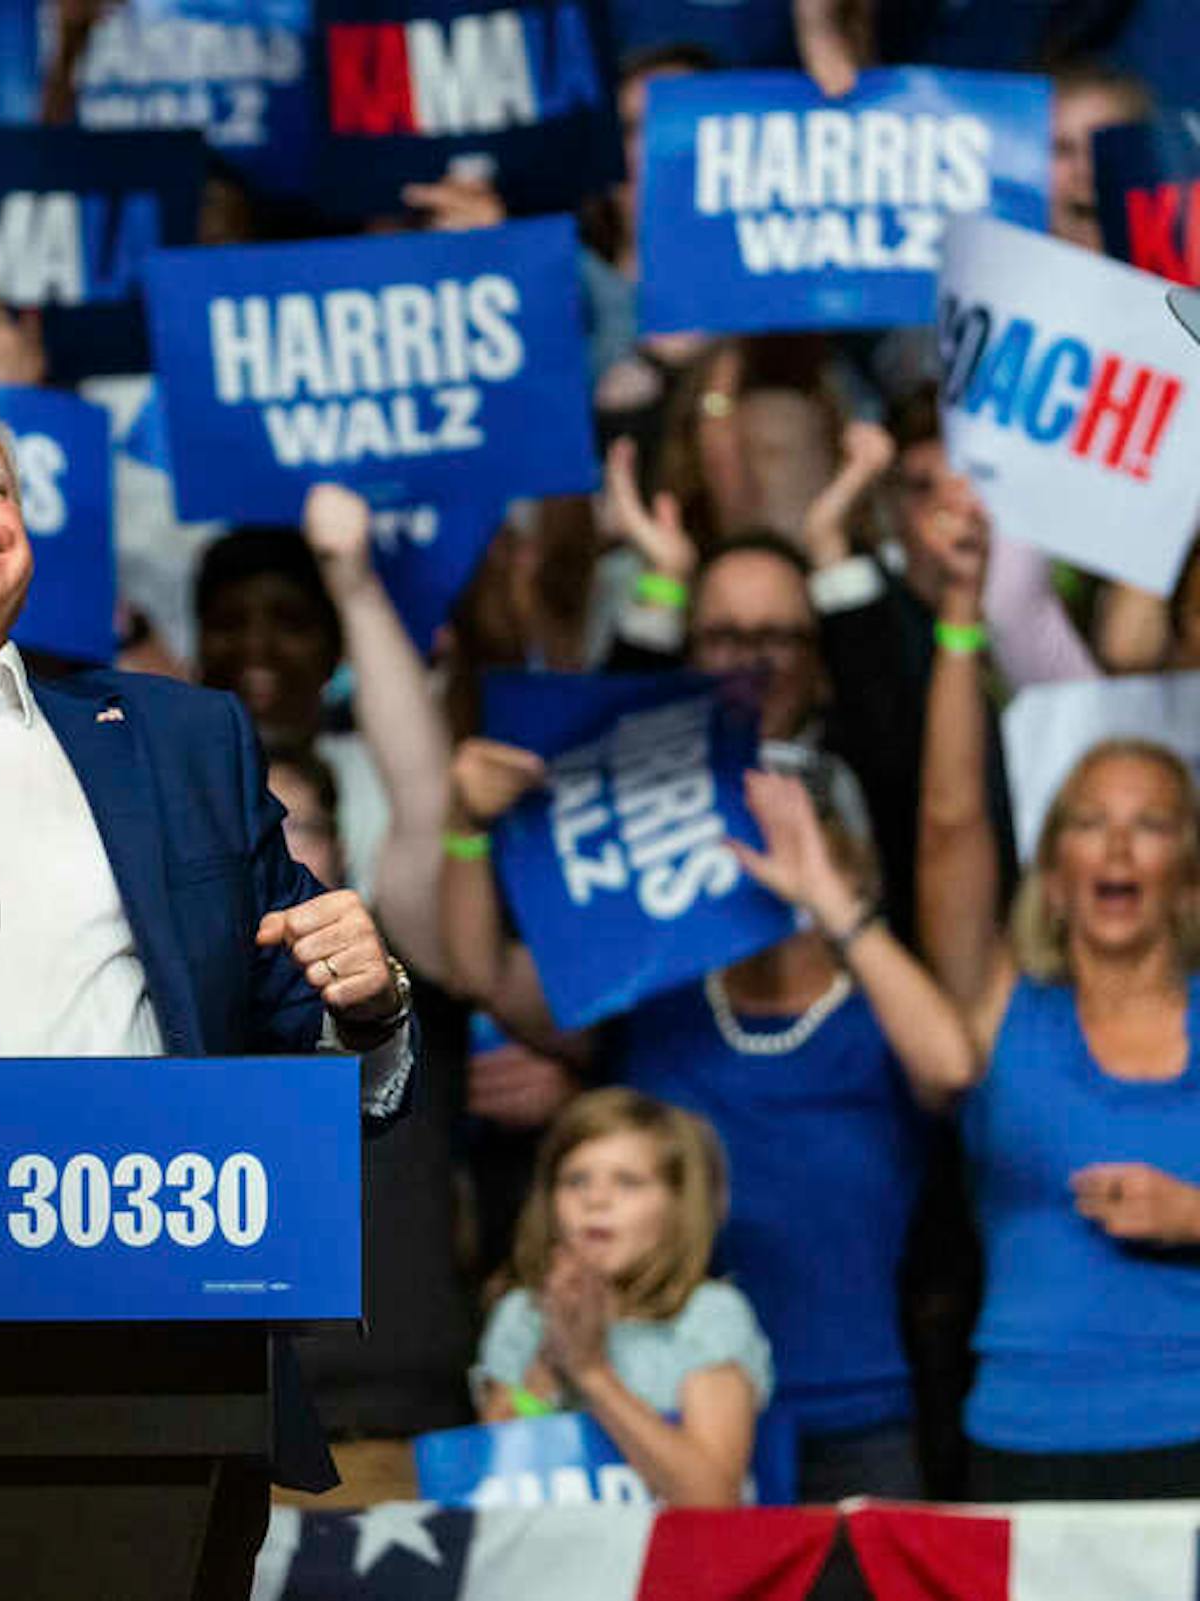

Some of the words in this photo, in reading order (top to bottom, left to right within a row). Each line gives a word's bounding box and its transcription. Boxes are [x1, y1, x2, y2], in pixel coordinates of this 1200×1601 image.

[696, 108, 992, 214] HARRIS
[736, 208, 946, 274] WALZ
[208, 272, 525, 405] HARRIS
[263, 384, 485, 467] WALZ
[7, 1151, 269, 1249] 30330
